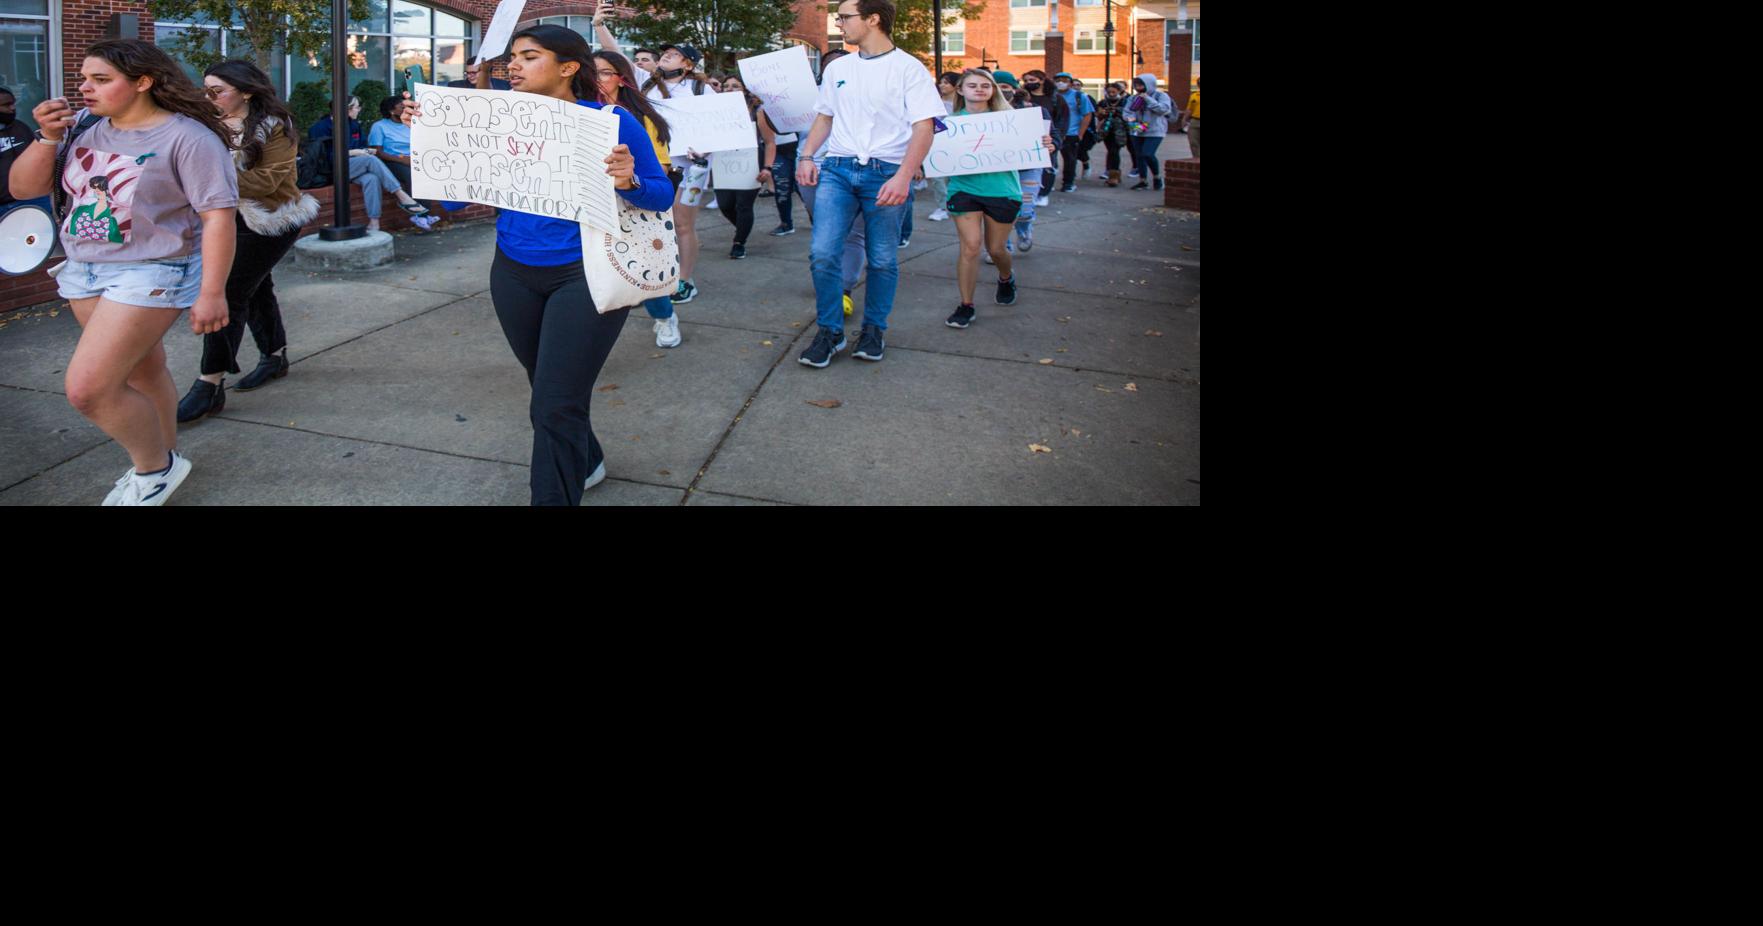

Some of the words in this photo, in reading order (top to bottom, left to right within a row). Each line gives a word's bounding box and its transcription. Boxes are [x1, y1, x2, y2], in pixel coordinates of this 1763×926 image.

[419, 91, 576, 143] Consent
[944, 113, 1019, 138] Drunk
[446, 132, 459, 147] IS
[467, 133, 502, 150] NOT
[507, 136, 545, 160] SEXY
[930, 140, 1043, 174] Consent
[422, 148, 582, 201] Consent
[720, 159, 750, 175] YOU
[444, 184, 457, 200] IS
[467, 185, 582, 220] MANDATORY
[606, 252, 638, 286] KINDNESS
